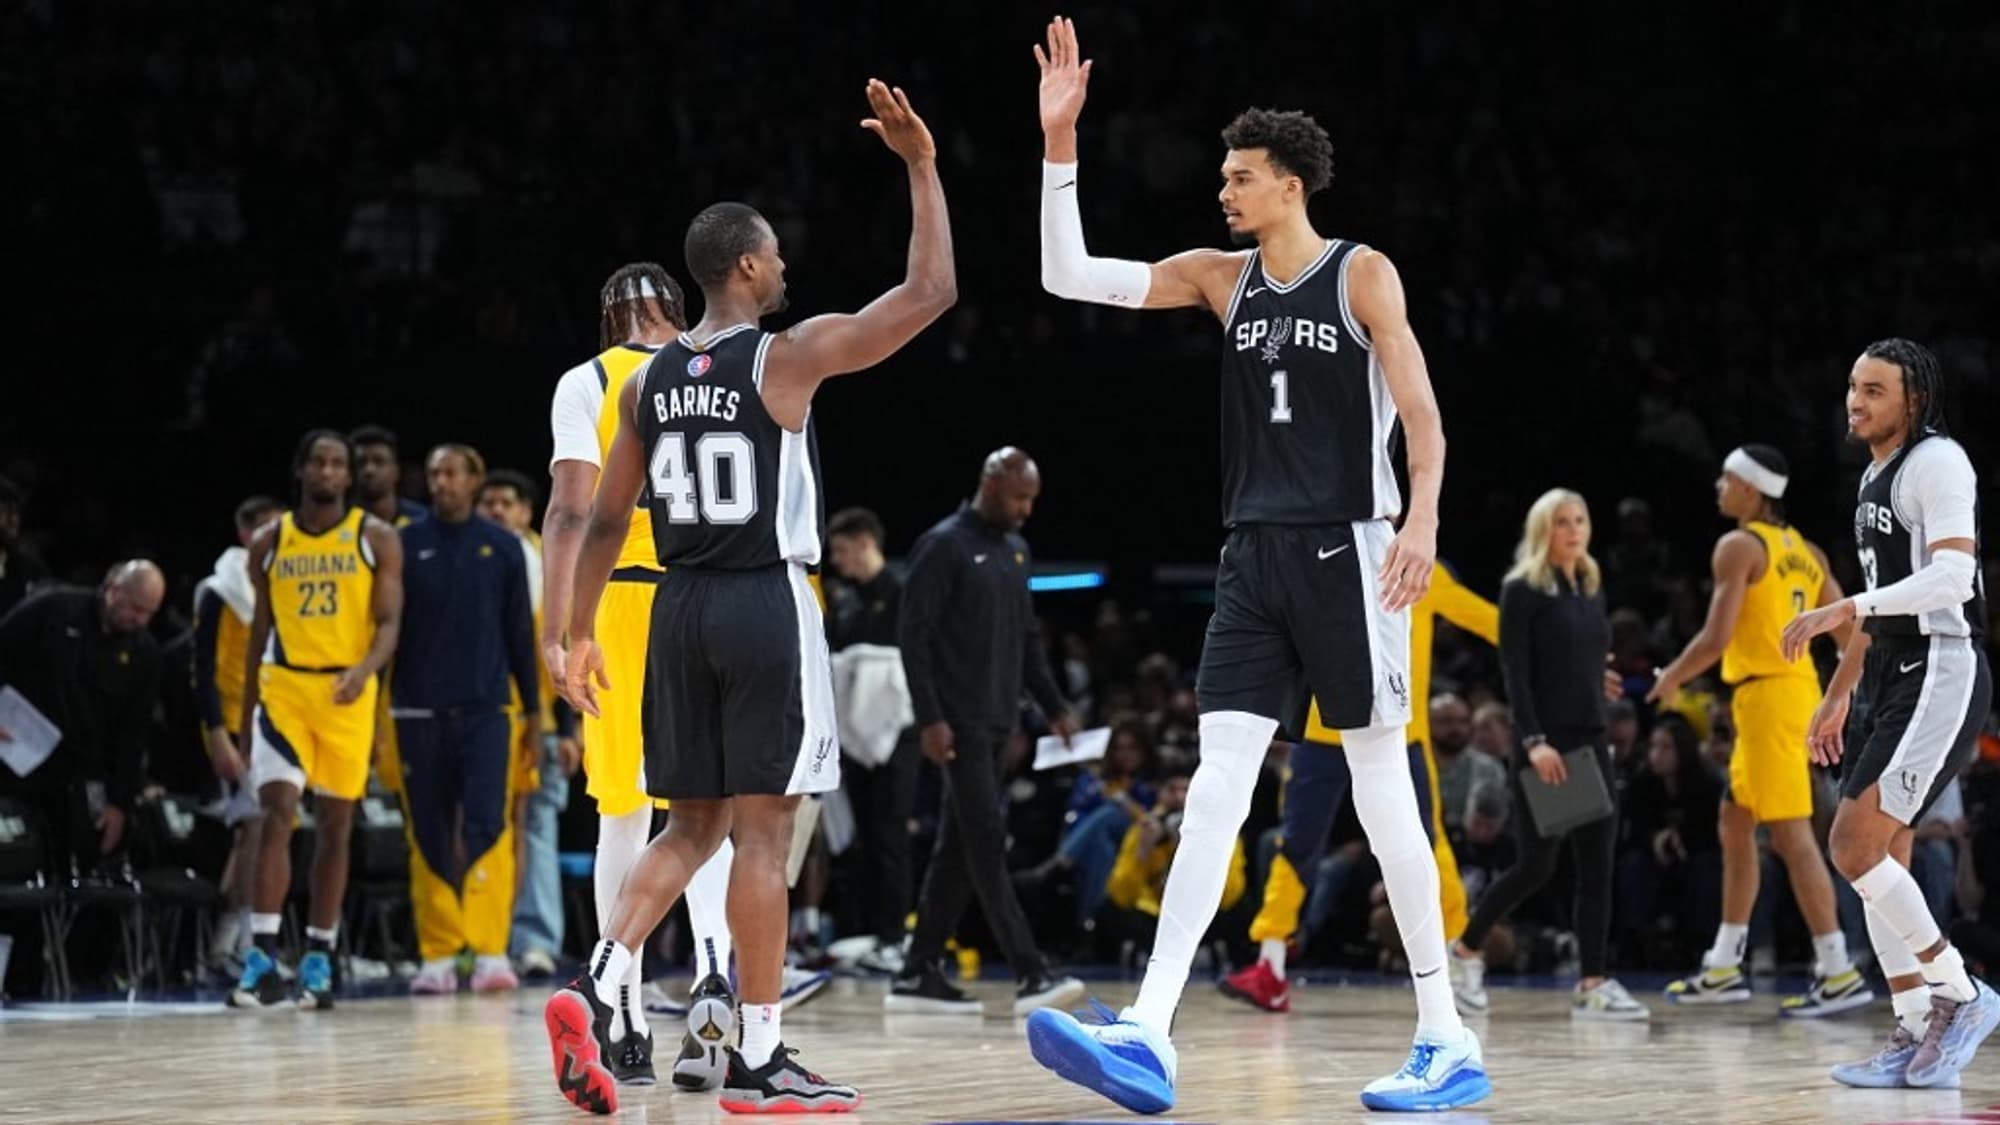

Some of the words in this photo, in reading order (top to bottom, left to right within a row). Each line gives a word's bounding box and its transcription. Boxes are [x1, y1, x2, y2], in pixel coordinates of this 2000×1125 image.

[1236, 316, 1338, 354] SPURS
[654, 385, 740, 423] BARNES
[1270, 370, 1292, 423] 1
[650, 432, 758, 524] 40
[277, 553, 358, 578] INDIANA
[298, 581, 337, 616] 23
